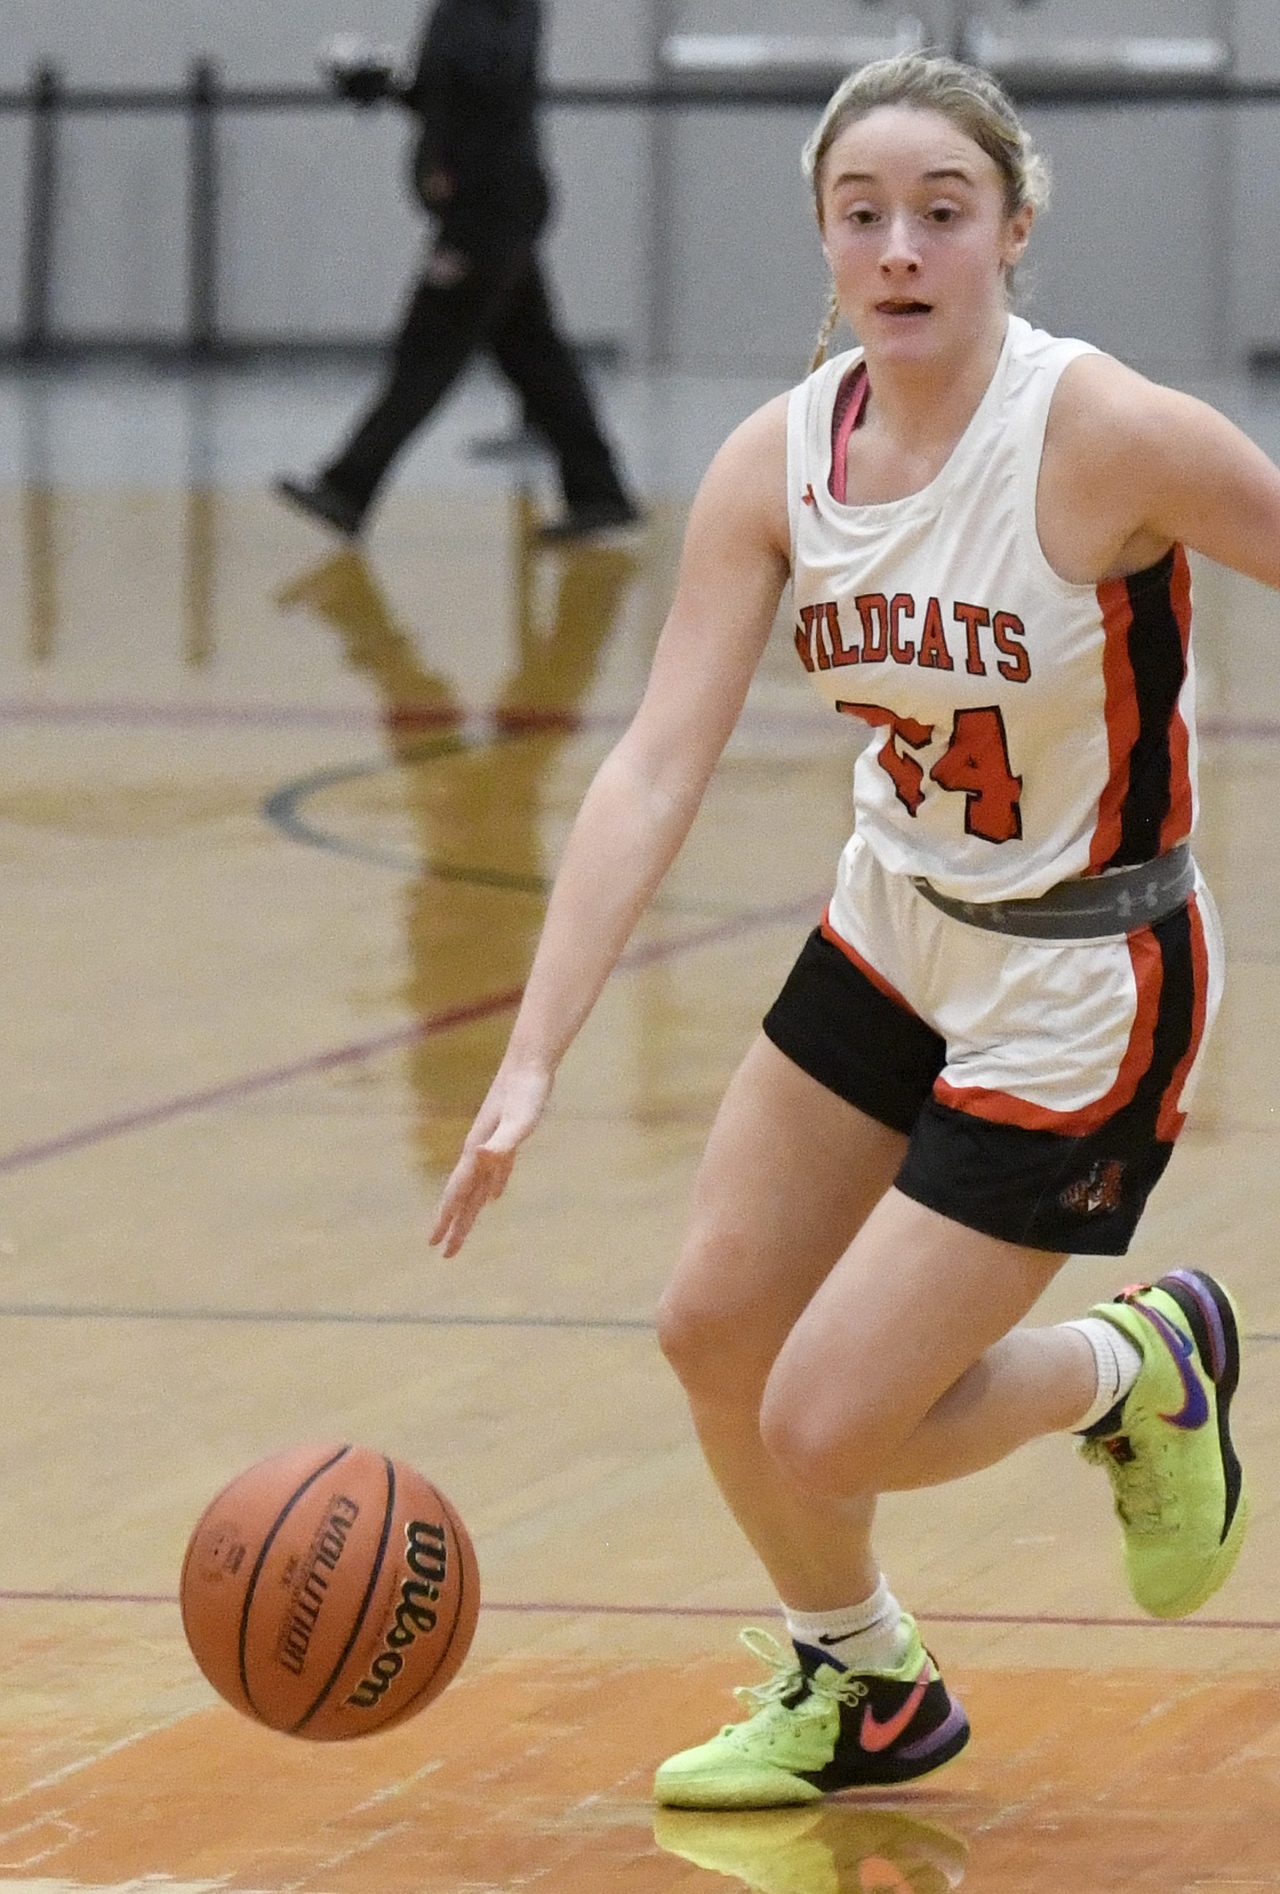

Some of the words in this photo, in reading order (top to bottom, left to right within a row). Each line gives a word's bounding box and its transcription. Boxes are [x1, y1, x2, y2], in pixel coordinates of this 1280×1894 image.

[794, 593, 1032, 683] WILDCATS
[278, 1492, 360, 1677] EVOLUTION
[345, 1518, 448, 1709] Wilson
